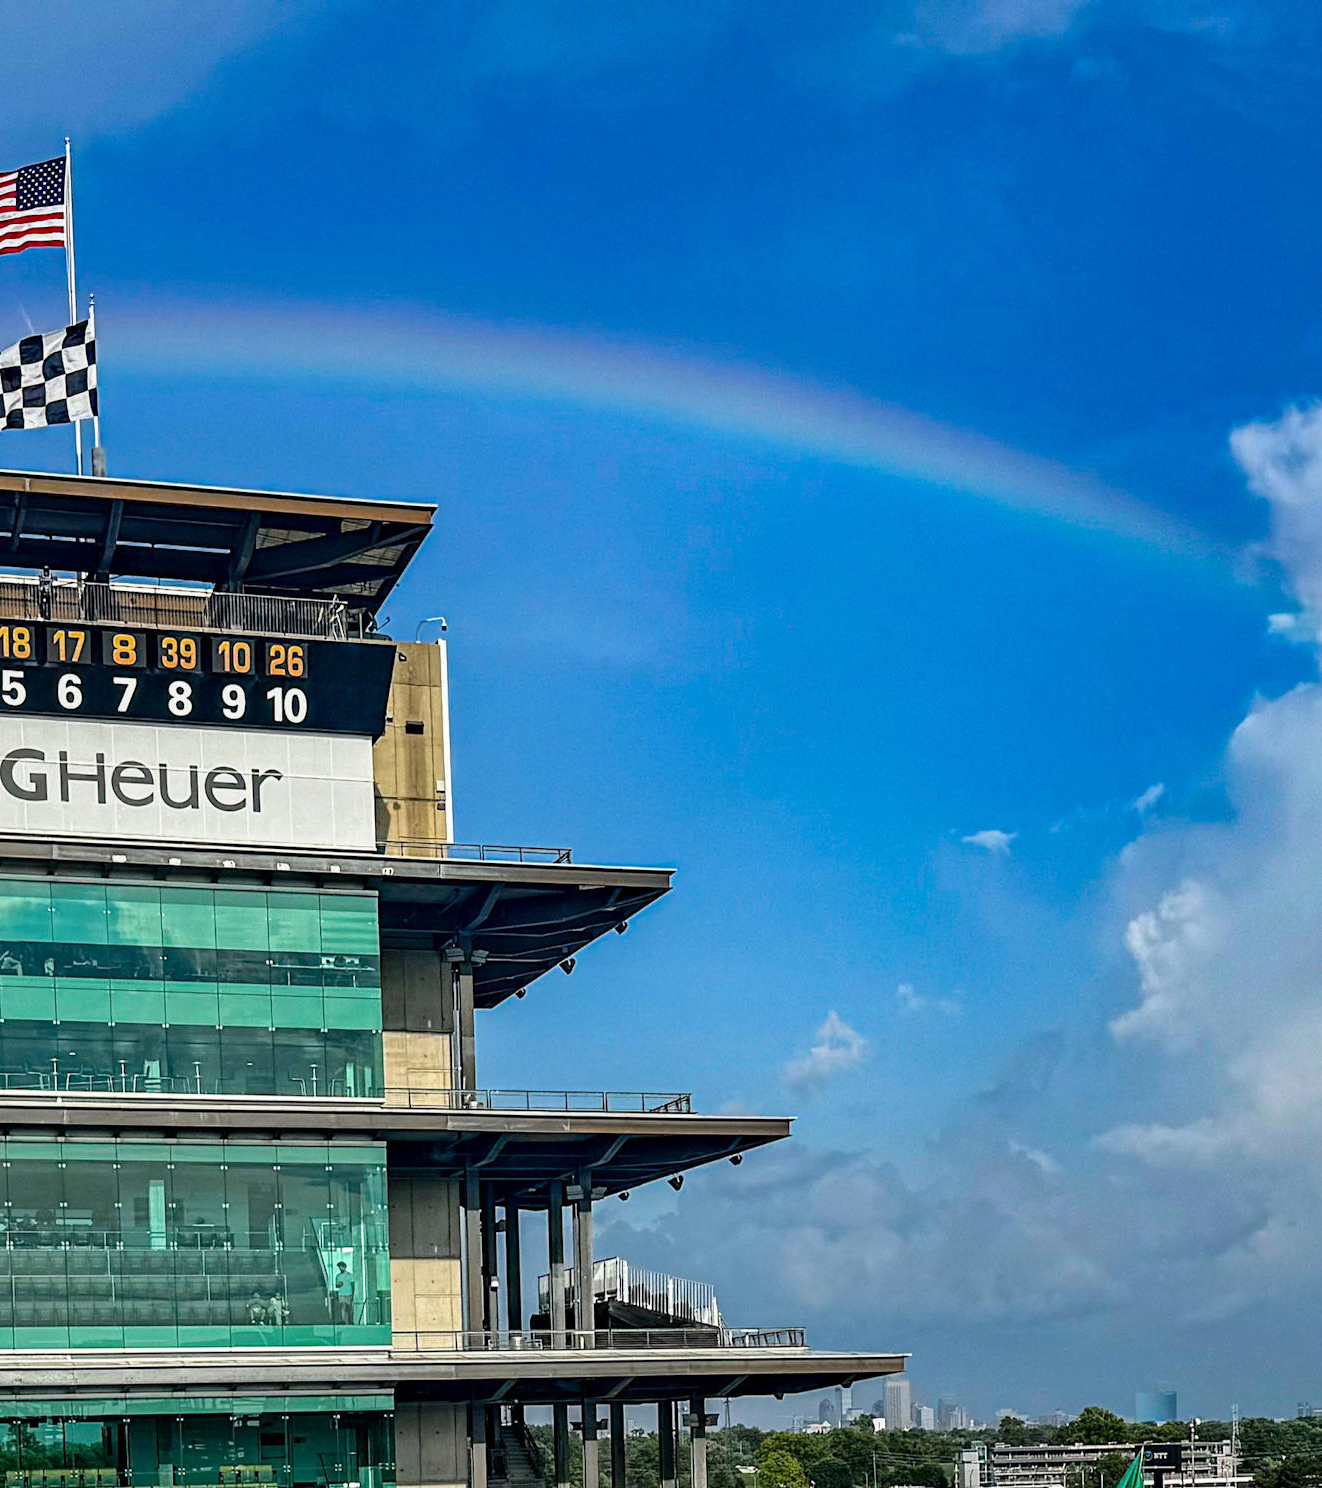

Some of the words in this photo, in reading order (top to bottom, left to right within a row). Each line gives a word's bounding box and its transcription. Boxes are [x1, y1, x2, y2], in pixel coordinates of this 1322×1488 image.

[53, 630, 85, 662] 17
[112, 634, 137, 665] 8
[161, 637, 197, 670] 39
[218, 641, 251, 673] 10
[269, 645, 304, 677] 26
[2, 670, 26, 706] 5
[57, 673, 83, 710] 6
[113, 677, 137, 712] 7
[168, 681, 193, 716] 8
[222, 684, 246, 719] 9
[266, 687, 307, 723] 10
